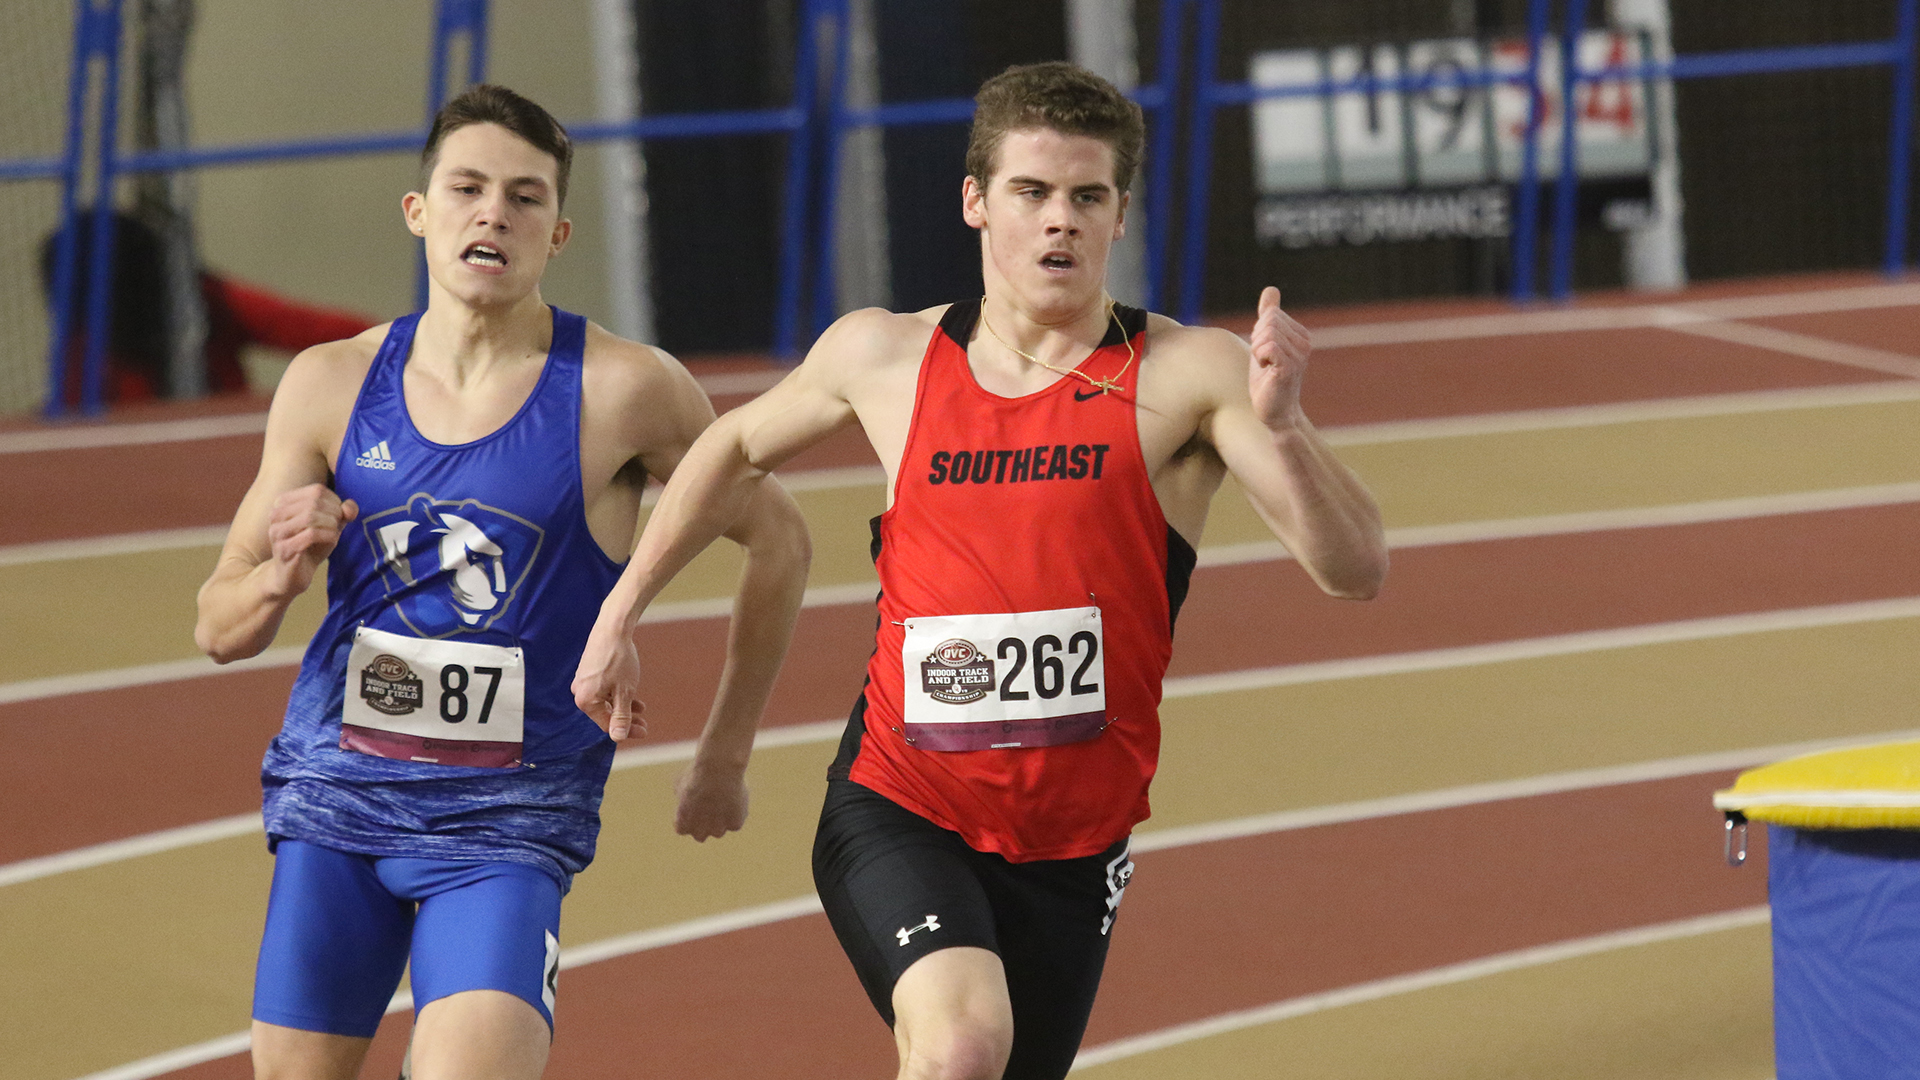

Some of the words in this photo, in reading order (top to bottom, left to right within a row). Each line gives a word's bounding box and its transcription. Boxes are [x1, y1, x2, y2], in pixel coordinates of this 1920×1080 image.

[1257, 190, 1508, 246] PERFORMANCE
[356, 457, 396, 470] adidas
[928, 444, 1110, 485] SOUTHEAST
[944, 648, 966, 659] OVC
[380, 663, 400, 674] OVC
[927, 669, 957, 677] INDOOR
[959, 667, 989, 677] TRACK
[997, 630, 1099, 702] 262
[954, 676, 989, 684] FIELD
[366, 685, 385, 695] AND
[388, 690, 418, 699] FIELD
[392, 683, 418, 693] TRACK
[440, 663, 503, 724] 87
[936, 691, 980, 700] CHAMPIONSHIP
